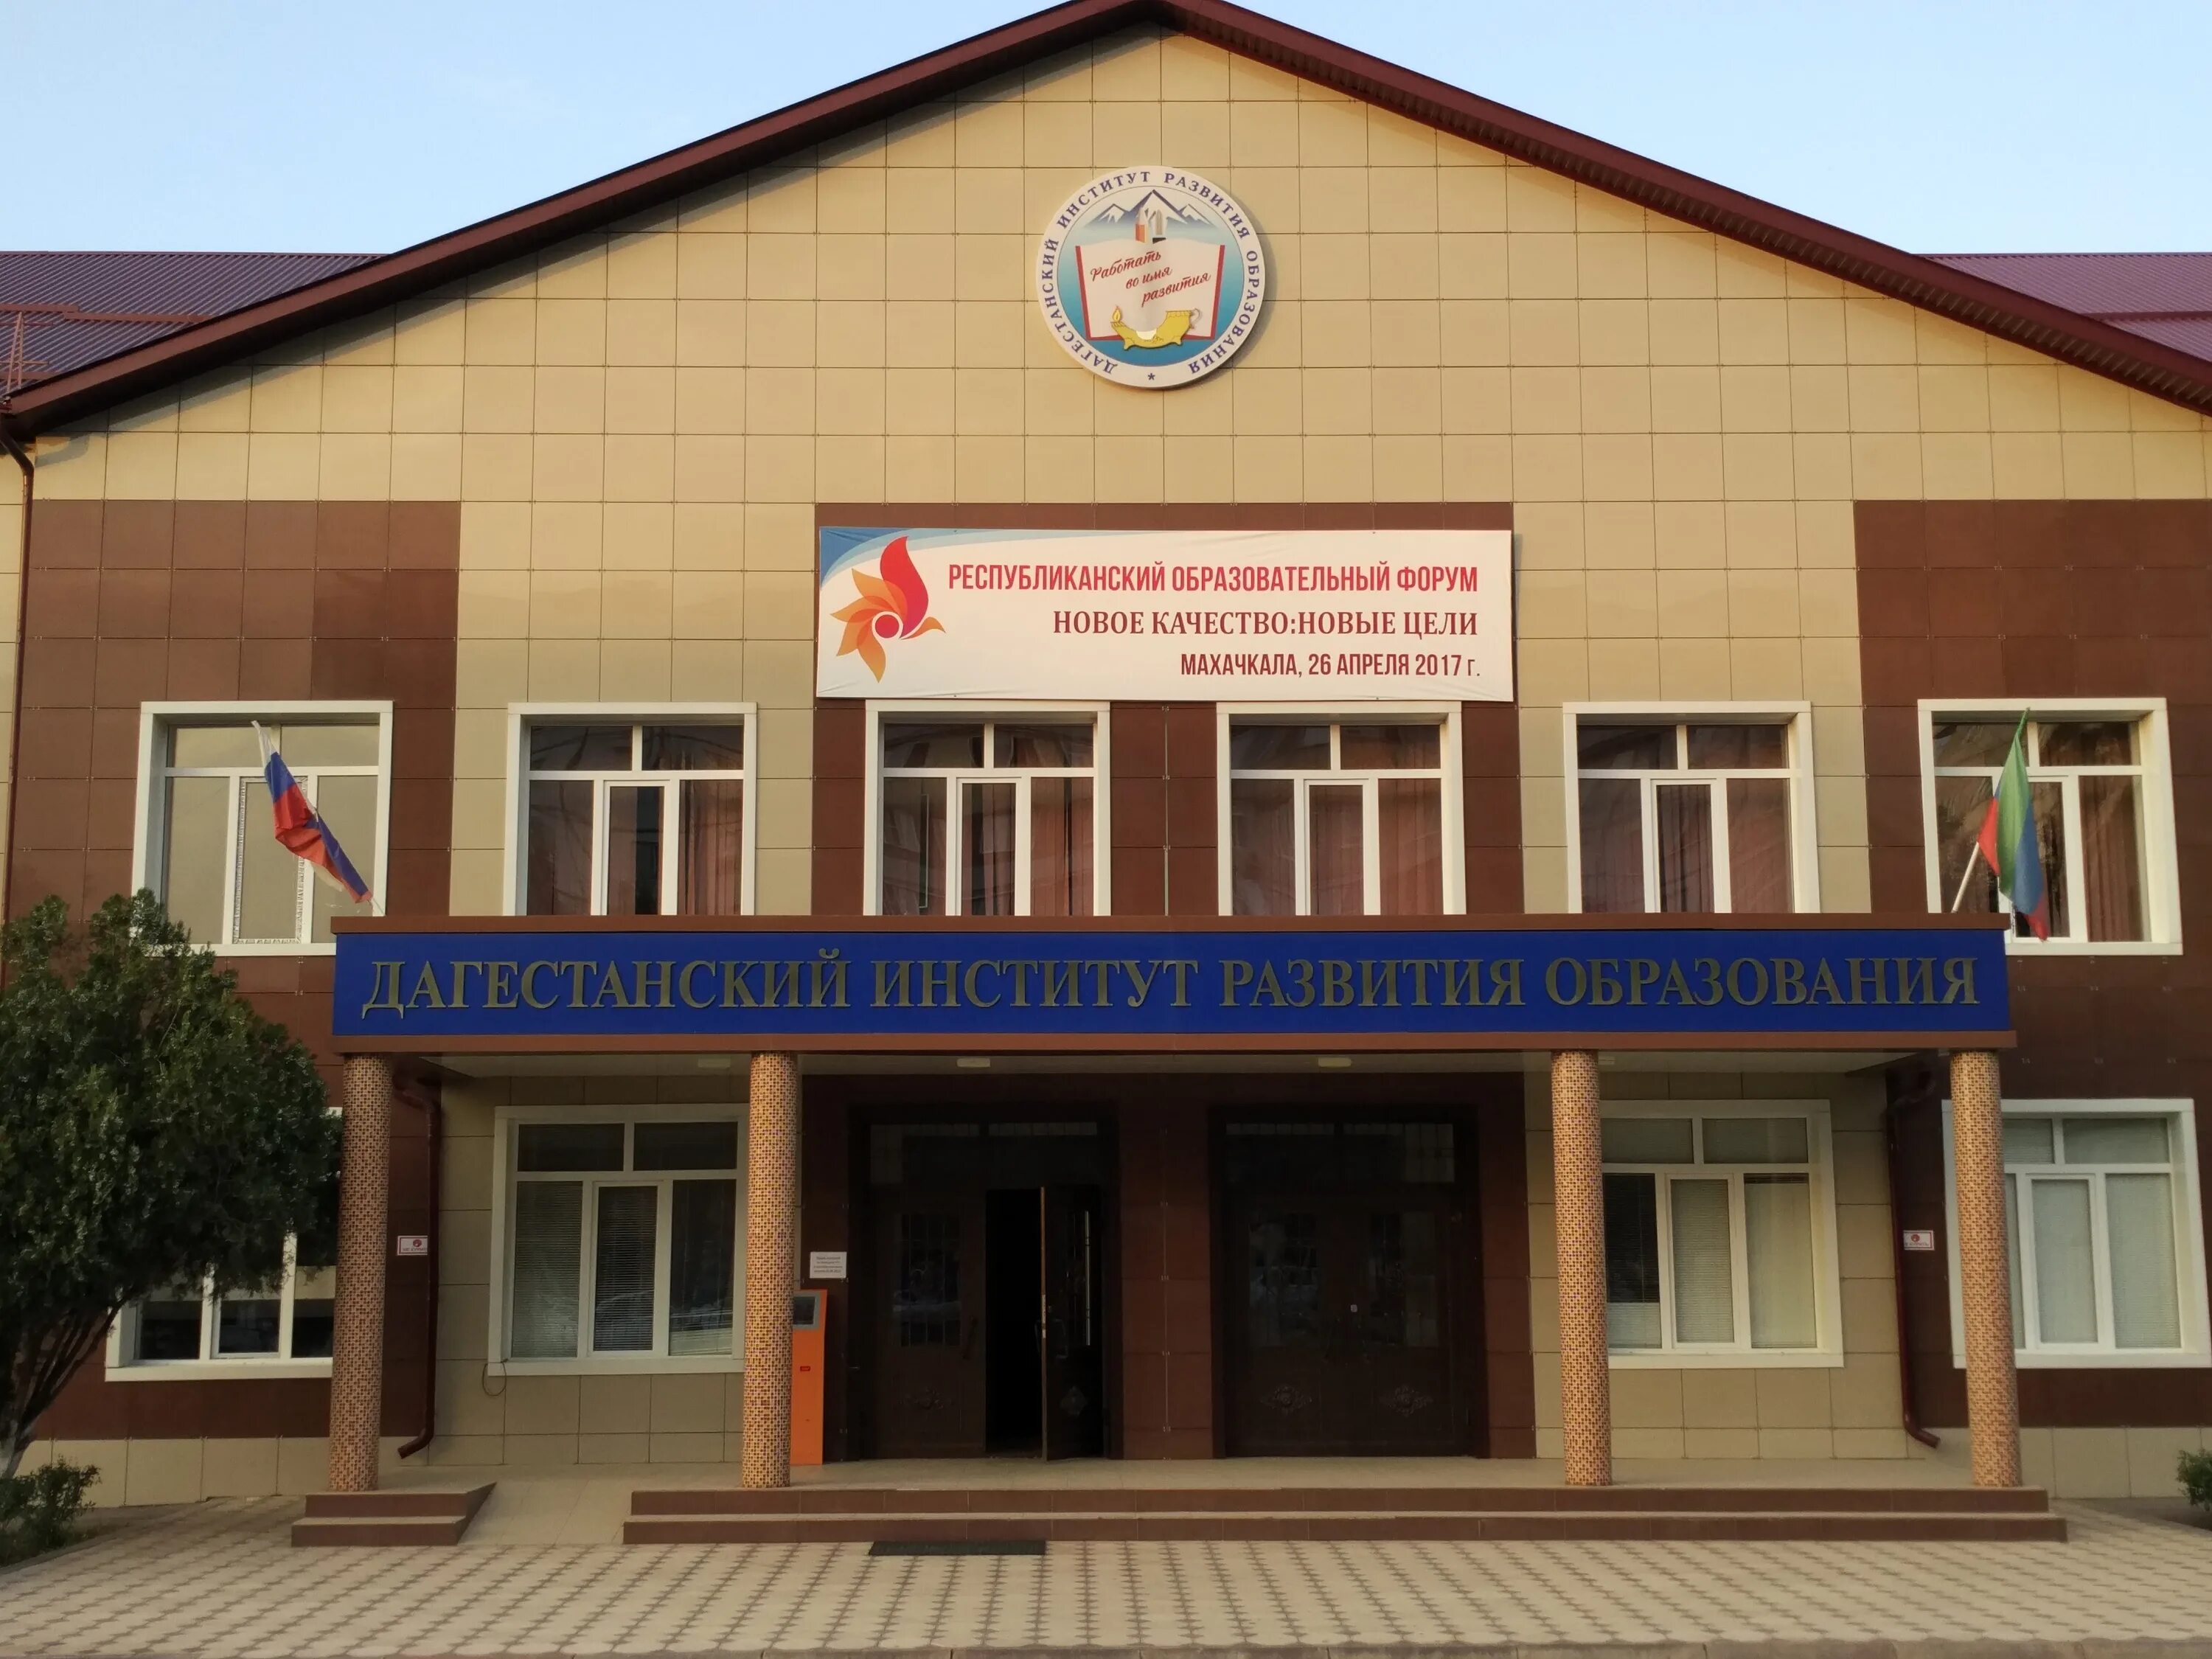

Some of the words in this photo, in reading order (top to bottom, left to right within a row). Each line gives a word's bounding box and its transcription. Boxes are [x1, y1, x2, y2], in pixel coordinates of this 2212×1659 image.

[1057, 171, 1151, 229] ИНСТИТУТ
[1164, 172, 1251, 239] РАЗВИТИЯ
[1090, 250, 1162, 282] Работать
[1125, 277, 1140, 290] во
[1141, 266, 1173, 285] имя
[1041, 238, 1118, 375] ДАГЕСТАНСКИЙ
[1141, 272, 1211, 307] развития
[1188, 251, 1260, 374] ОБРАЗОВАНИЯ
[948, 561, 1166, 591] РЕСПУБЛИКАНСКИЙ
[1172, 560, 1391, 591] ОБРАЗОВАТЕЛЬНЫЙ
[1397, 566, 1478, 592] ФОРУМ
[1053, 611, 1144, 634] НОВОЕ
[1403, 612, 1478, 640] ЦЕЛИ
[1180, 653, 1303, 678] МАХАЧКАЛА,
[1308, 653, 1332, 675] 26
[1336, 653, 1410, 675] АПРЕЛЯ
[1415, 653, 1462, 676] 2017
[1467, 658, 1481, 677] г.
[361, 947, 852, 1019] ДАГЕСТАНСКИЙ
[869, 959, 1199, 1008] ИНСТИТУТ
[1218, 959, 1526, 1008] РАЗВИТИЯ
[1545, 956, 1980, 1007] ОБРАЗОВАНИЯ
